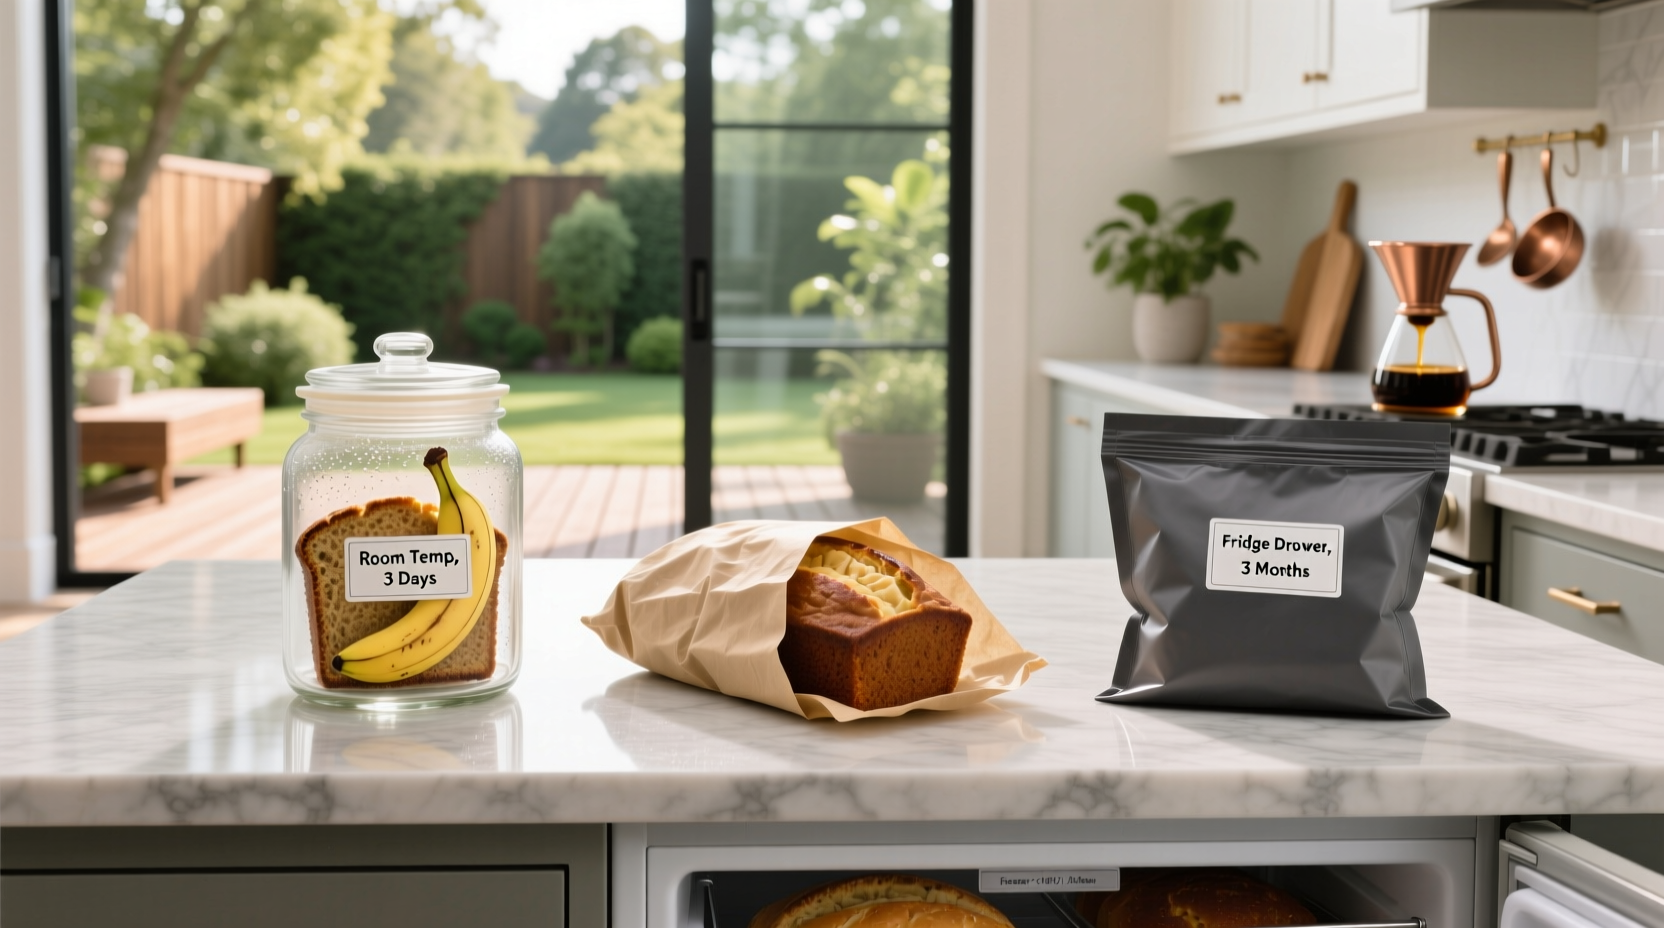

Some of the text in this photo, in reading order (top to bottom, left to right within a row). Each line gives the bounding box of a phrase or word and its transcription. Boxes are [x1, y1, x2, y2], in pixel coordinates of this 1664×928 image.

[1222, 534, 1270, 554] Fridge
[359, 549, 460, 568] Room Temp,
[1241, 560, 1310, 578] 3 Months
[383, 570, 437, 590] 3 Days
